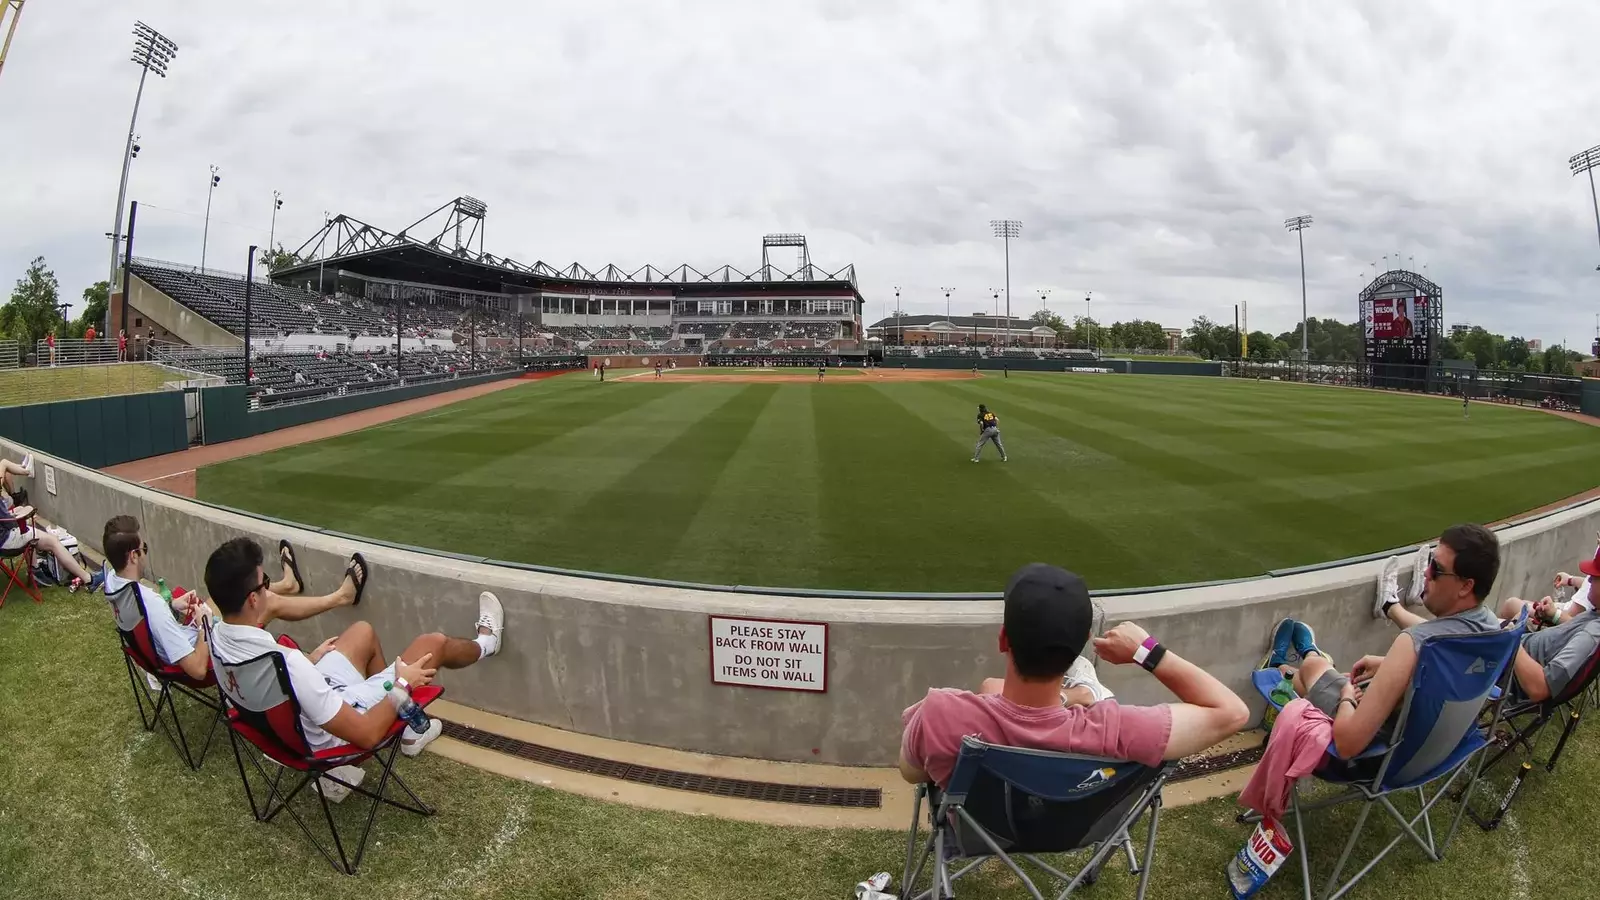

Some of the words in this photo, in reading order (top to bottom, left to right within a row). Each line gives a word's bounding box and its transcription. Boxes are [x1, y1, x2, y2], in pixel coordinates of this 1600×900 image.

[984, 413, 994, 421] 45
[730, 625, 773, 639] PLEASE
[777, 628, 806, 640] STAY
[715, 637, 746, 649] BACK
[751, 640, 784, 652] FROM
[789, 642, 822, 654] WALL
[735, 654, 752, 665] DO
[756, 656, 780, 668] NOT
[785, 658, 802, 669] SIT
[722, 666, 757, 678] ITEMS
[761, 669, 778, 680] ON
[782, 671, 815, 683] WALL
